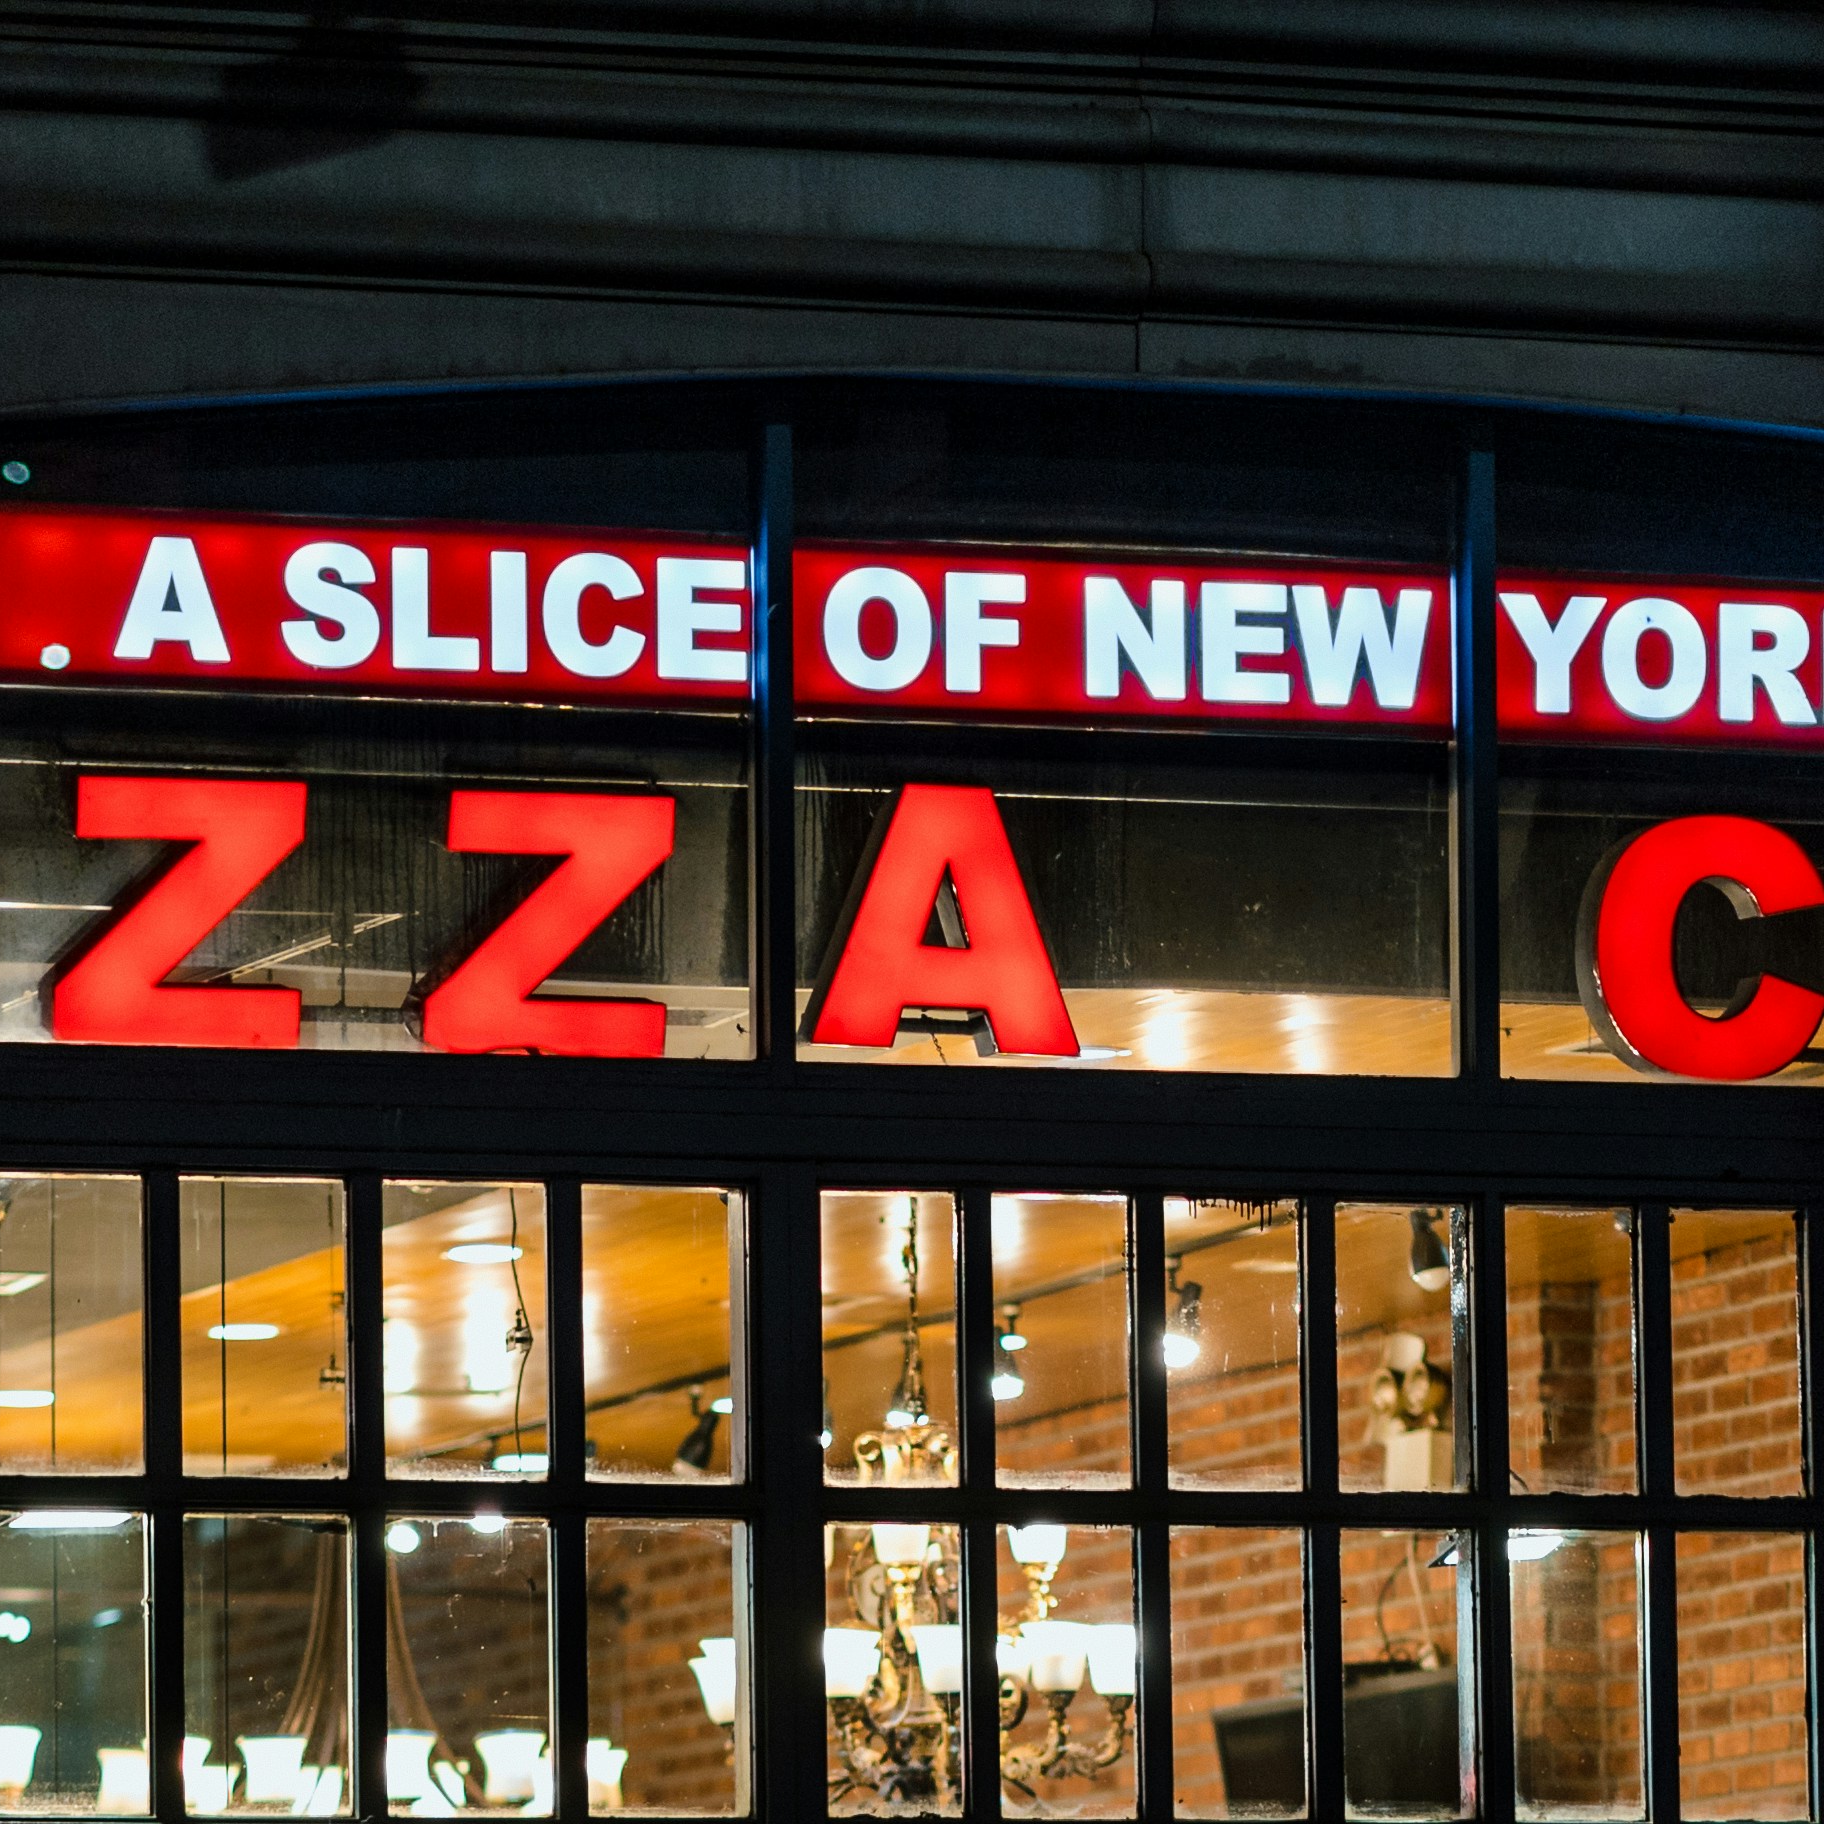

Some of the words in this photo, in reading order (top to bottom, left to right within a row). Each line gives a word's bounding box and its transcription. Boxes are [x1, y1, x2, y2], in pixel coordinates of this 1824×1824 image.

[112, 535, 232, 664] A
[280, 540, 748, 683] SLICE
[822, 566, 1027, 693] OF
[1083, 575, 1434, 711] NEW
